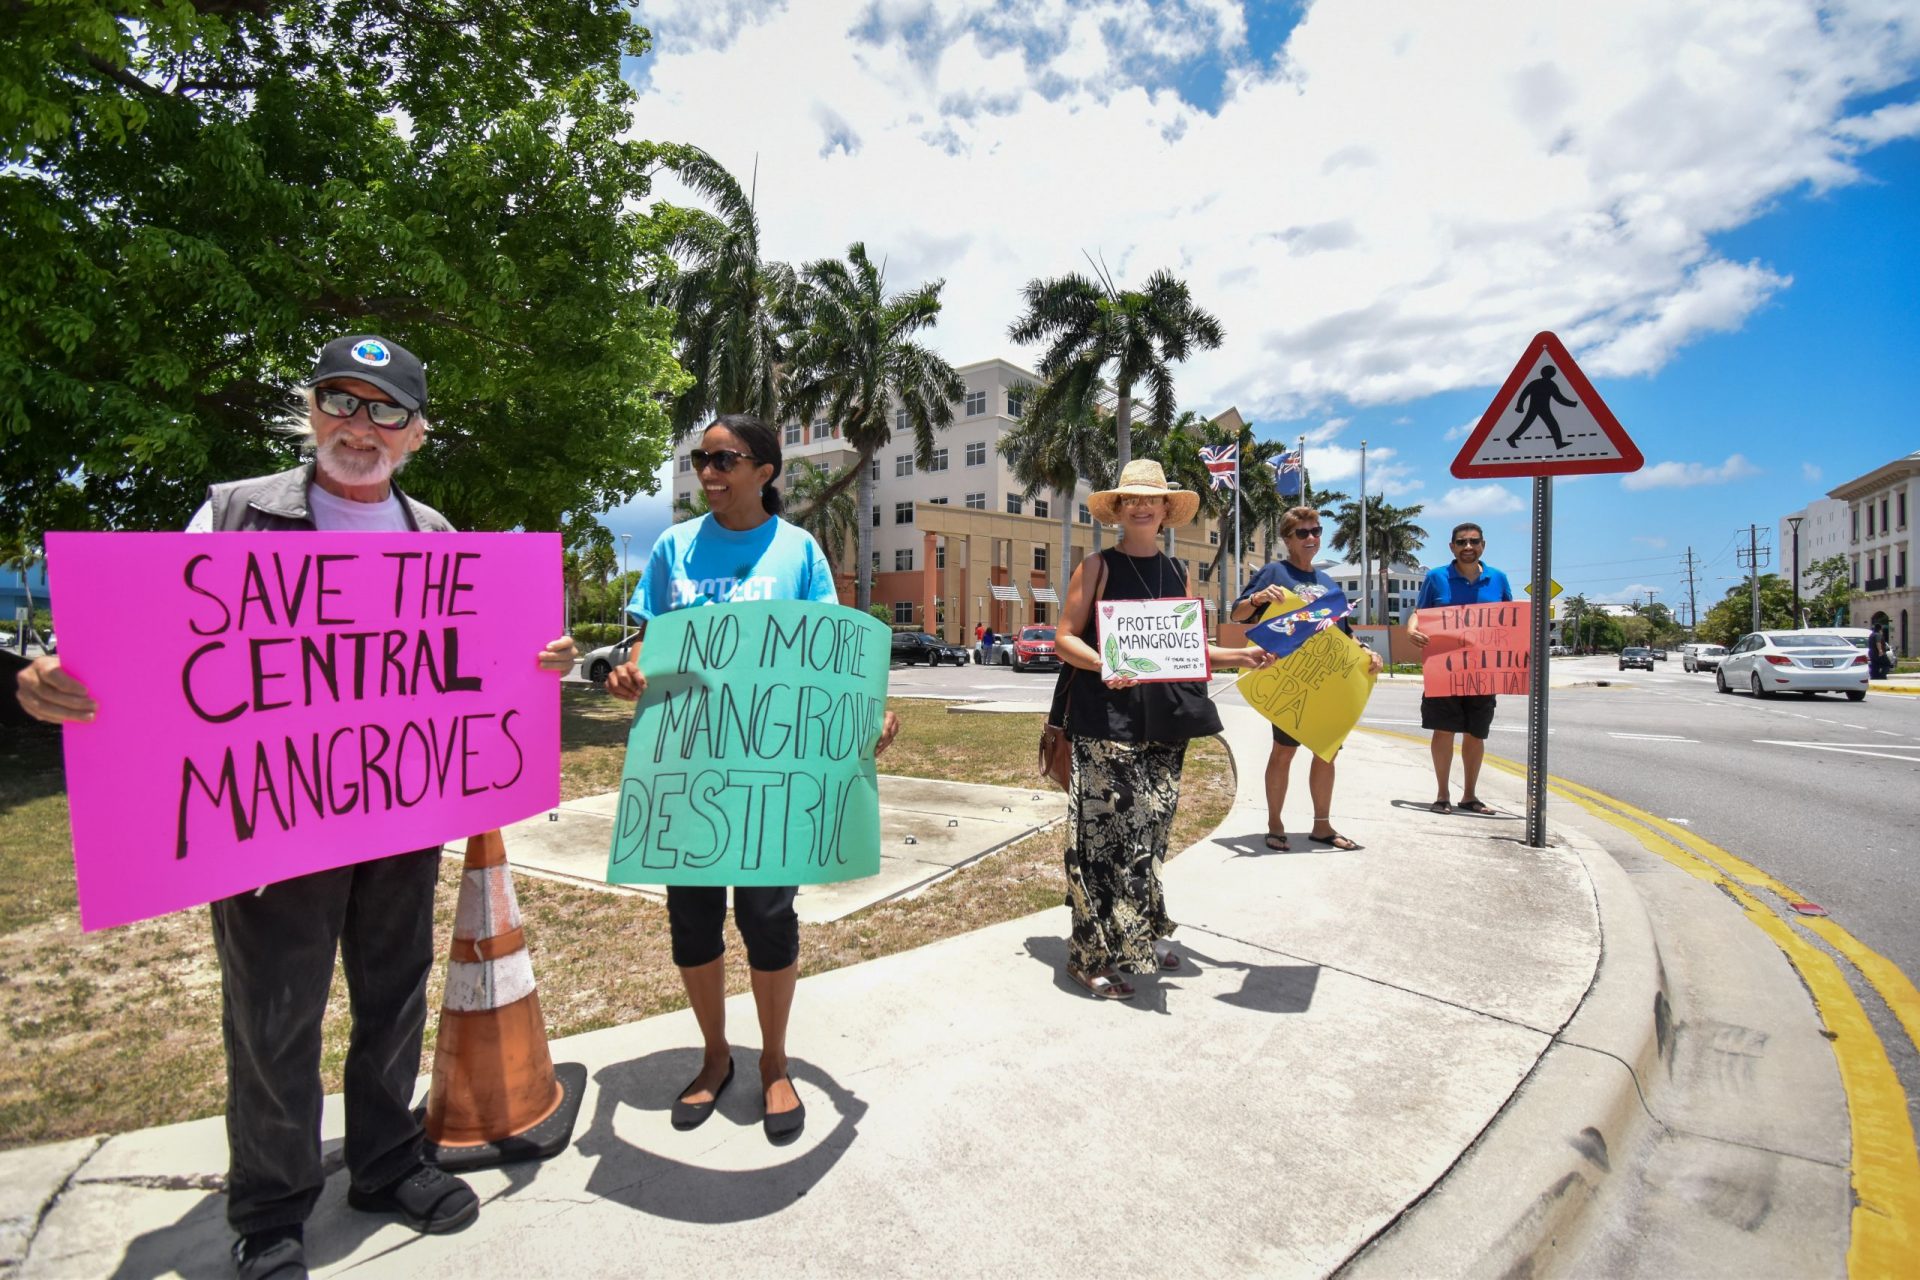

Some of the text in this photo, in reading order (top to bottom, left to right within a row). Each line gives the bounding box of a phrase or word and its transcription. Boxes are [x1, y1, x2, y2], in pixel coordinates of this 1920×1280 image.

[183, 551, 482, 636] SAVE THE
[1117, 615, 1182, 631] PROTECT
[1442, 607, 1520, 630] PROTECT
[678, 614, 872, 678] NO MORE
[1119, 632, 1200, 650] MANGROVES
[1282, 650, 1332, 691] THE
[182, 626, 482, 723] CENTRAL
[1250, 666, 1308, 730] CPA
[176, 709, 523, 860] MANGROVES
